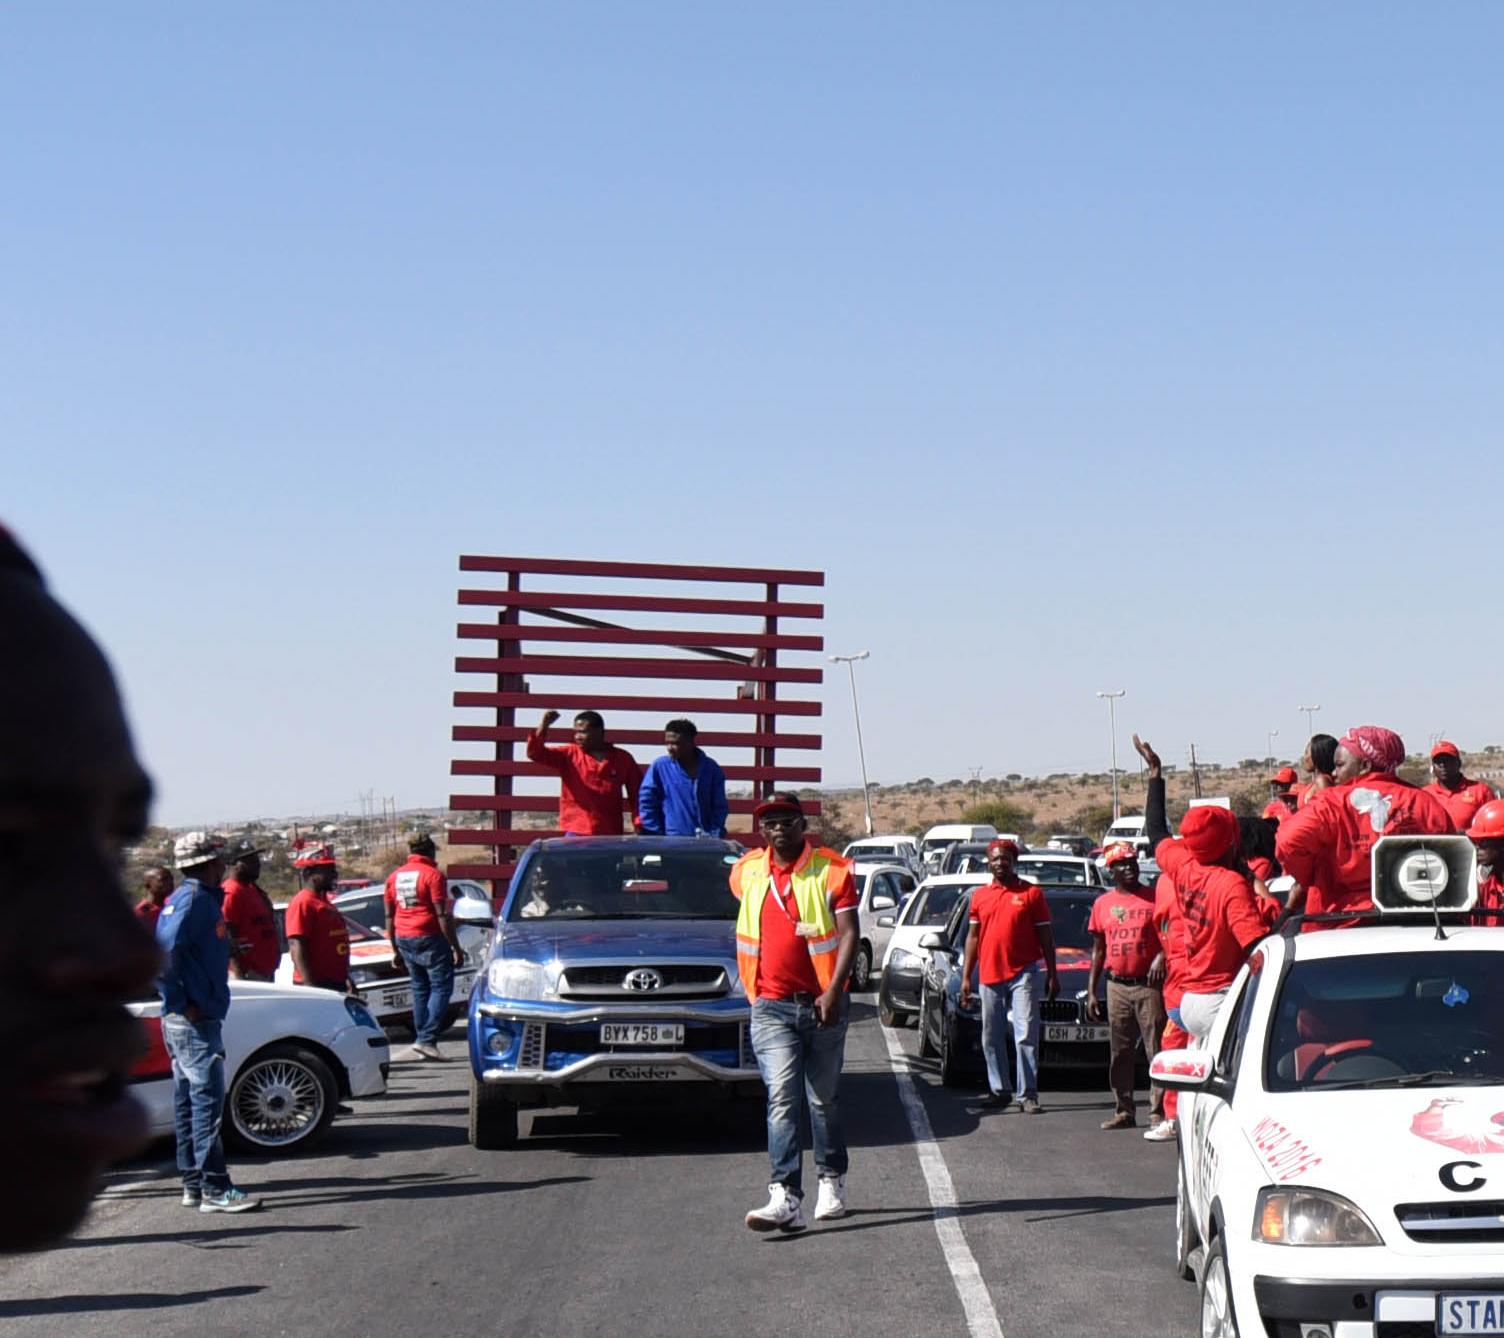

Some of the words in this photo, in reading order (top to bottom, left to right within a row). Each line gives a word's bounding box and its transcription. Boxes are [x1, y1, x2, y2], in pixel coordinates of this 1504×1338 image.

[603, 1025, 629, 1041] BYX
[632, 1025, 658, 1041] 758
[1048, 1028, 1069, 1040] CSH
[608, 1066, 678, 1079] Raider
